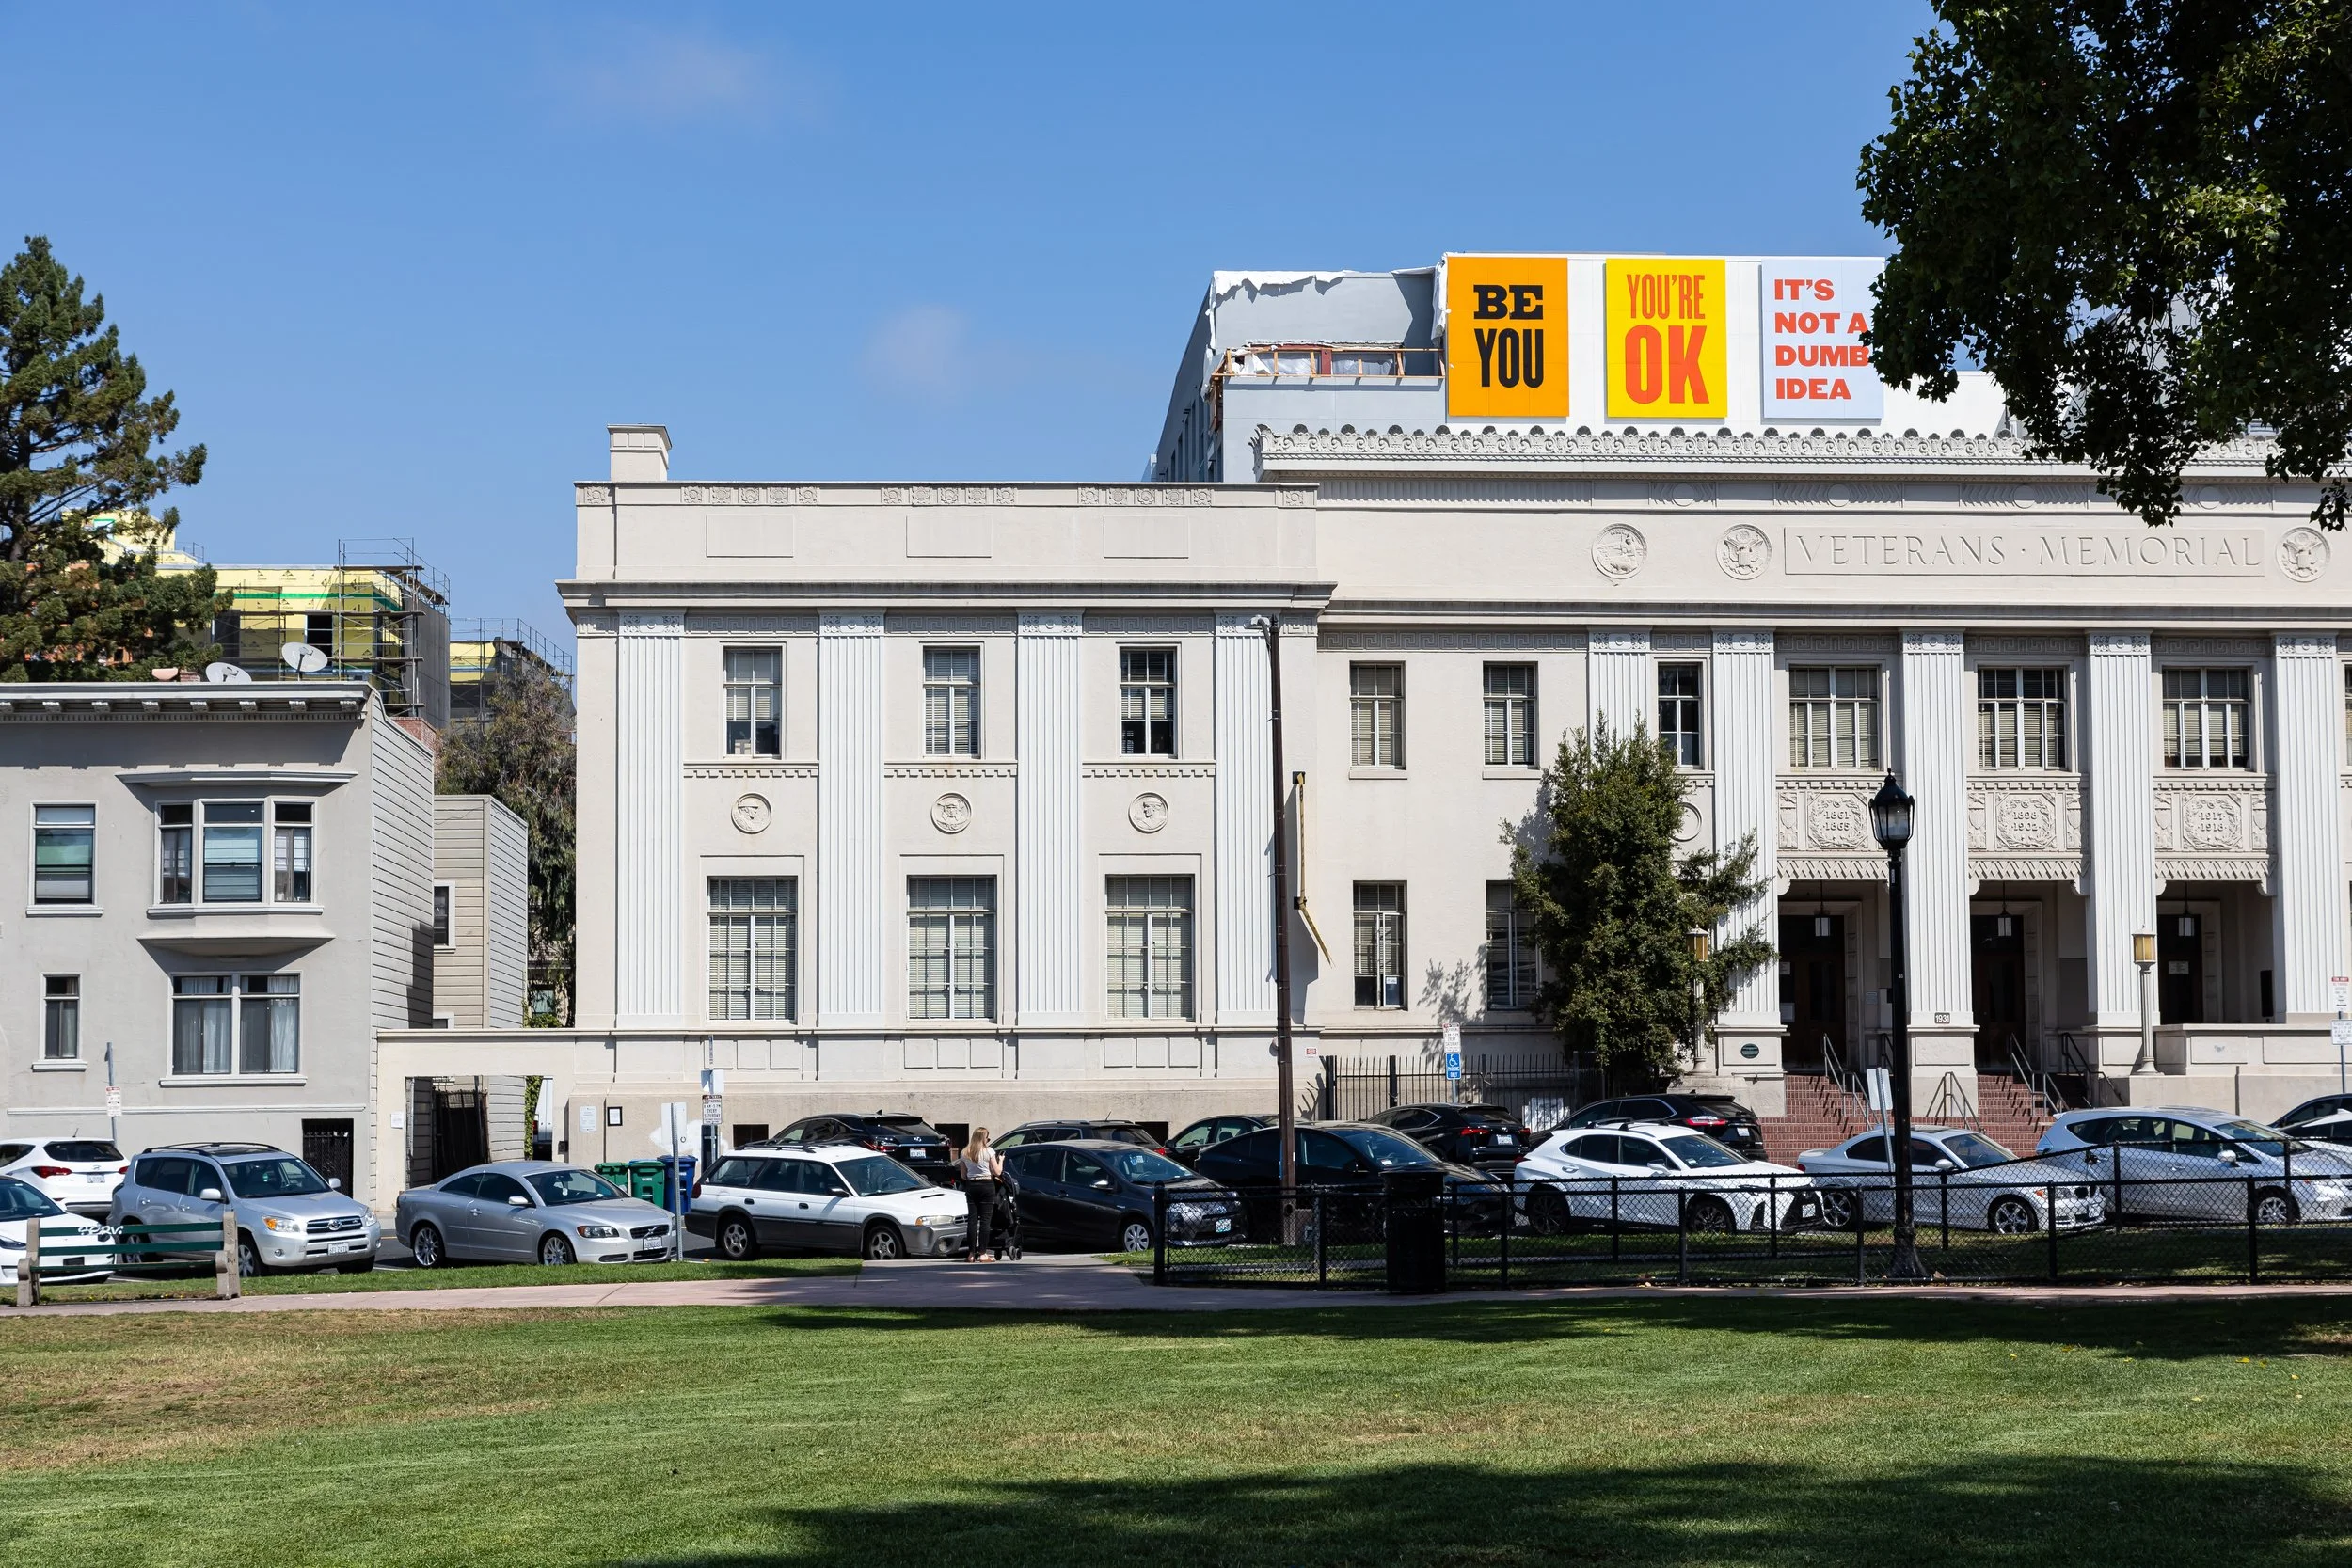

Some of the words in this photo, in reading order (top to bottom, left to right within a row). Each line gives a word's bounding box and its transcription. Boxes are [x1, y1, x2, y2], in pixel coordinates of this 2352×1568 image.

[1473, 285, 1543, 319] BE
[1627, 274, 1706, 319] YOU'RE
[1774, 279, 1835, 301] IT'S
[1775, 312, 1840, 334] NOT
[1847, 313, 1868, 333] A
[1474, 328, 1544, 388] YOU
[1625, 325, 1710, 404] OK
[1775, 346, 1869, 366] DUMB
[1776, 379, 1851, 399] IDEA
[1796, 535, 2005, 565] VETERANS
[2039, 536, 2262, 566] MEMORIAL
[1935, 1014, 1949, 1022] 1931
